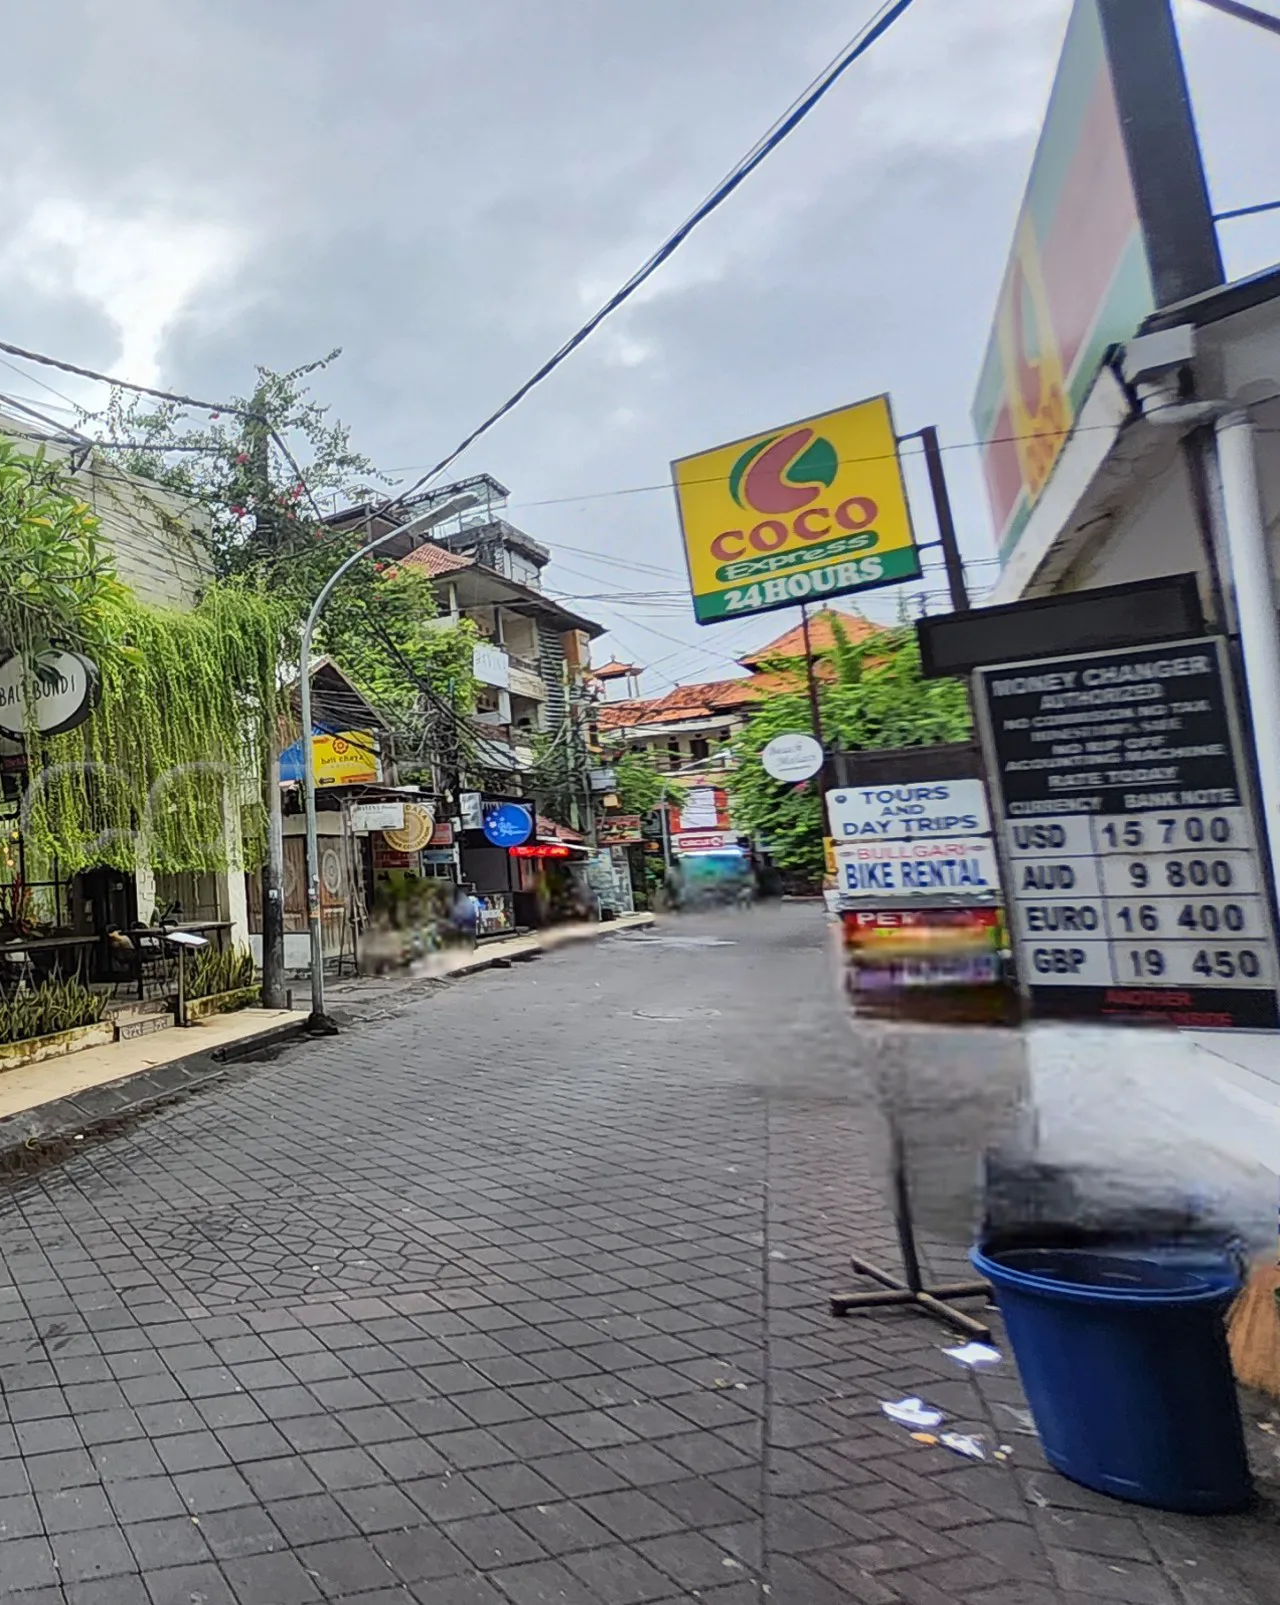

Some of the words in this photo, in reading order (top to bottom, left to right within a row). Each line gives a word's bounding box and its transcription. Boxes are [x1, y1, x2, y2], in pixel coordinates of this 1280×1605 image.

[710, 497, 878, 561] COCO
[722, 534, 870, 580] Express
[992, 671, 1077, 697] MONEY
[1082, 655, 1212, 686] CHANGER
[859, 786, 950, 804] TOURS
[880, 804, 925, 816] AND
[842, 820, 893, 836] DAY
[900, 815, 979, 832] TRIPS
[1013, 824, 1066, 849] USD
[1102, 820, 1142, 847] 15
[858, 844, 965, 860] BULLGARI
[845, 862, 895, 889] BIKE
[900, 859, 989, 888] RENTAL
[1022, 864, 1075, 890] AUD
[1129, 862, 1149, 888] 9
[1166, 860, 1233, 887] 800
[1026, 905, 1098, 932] EURO
[1117, 904, 1159, 932] 16
[1177, 904, 1245, 932] 400
[1033, 948, 1087, 974] GBP
[1130, 949, 1166, 977] 19
[1193, 949, 1260, 978] 450
